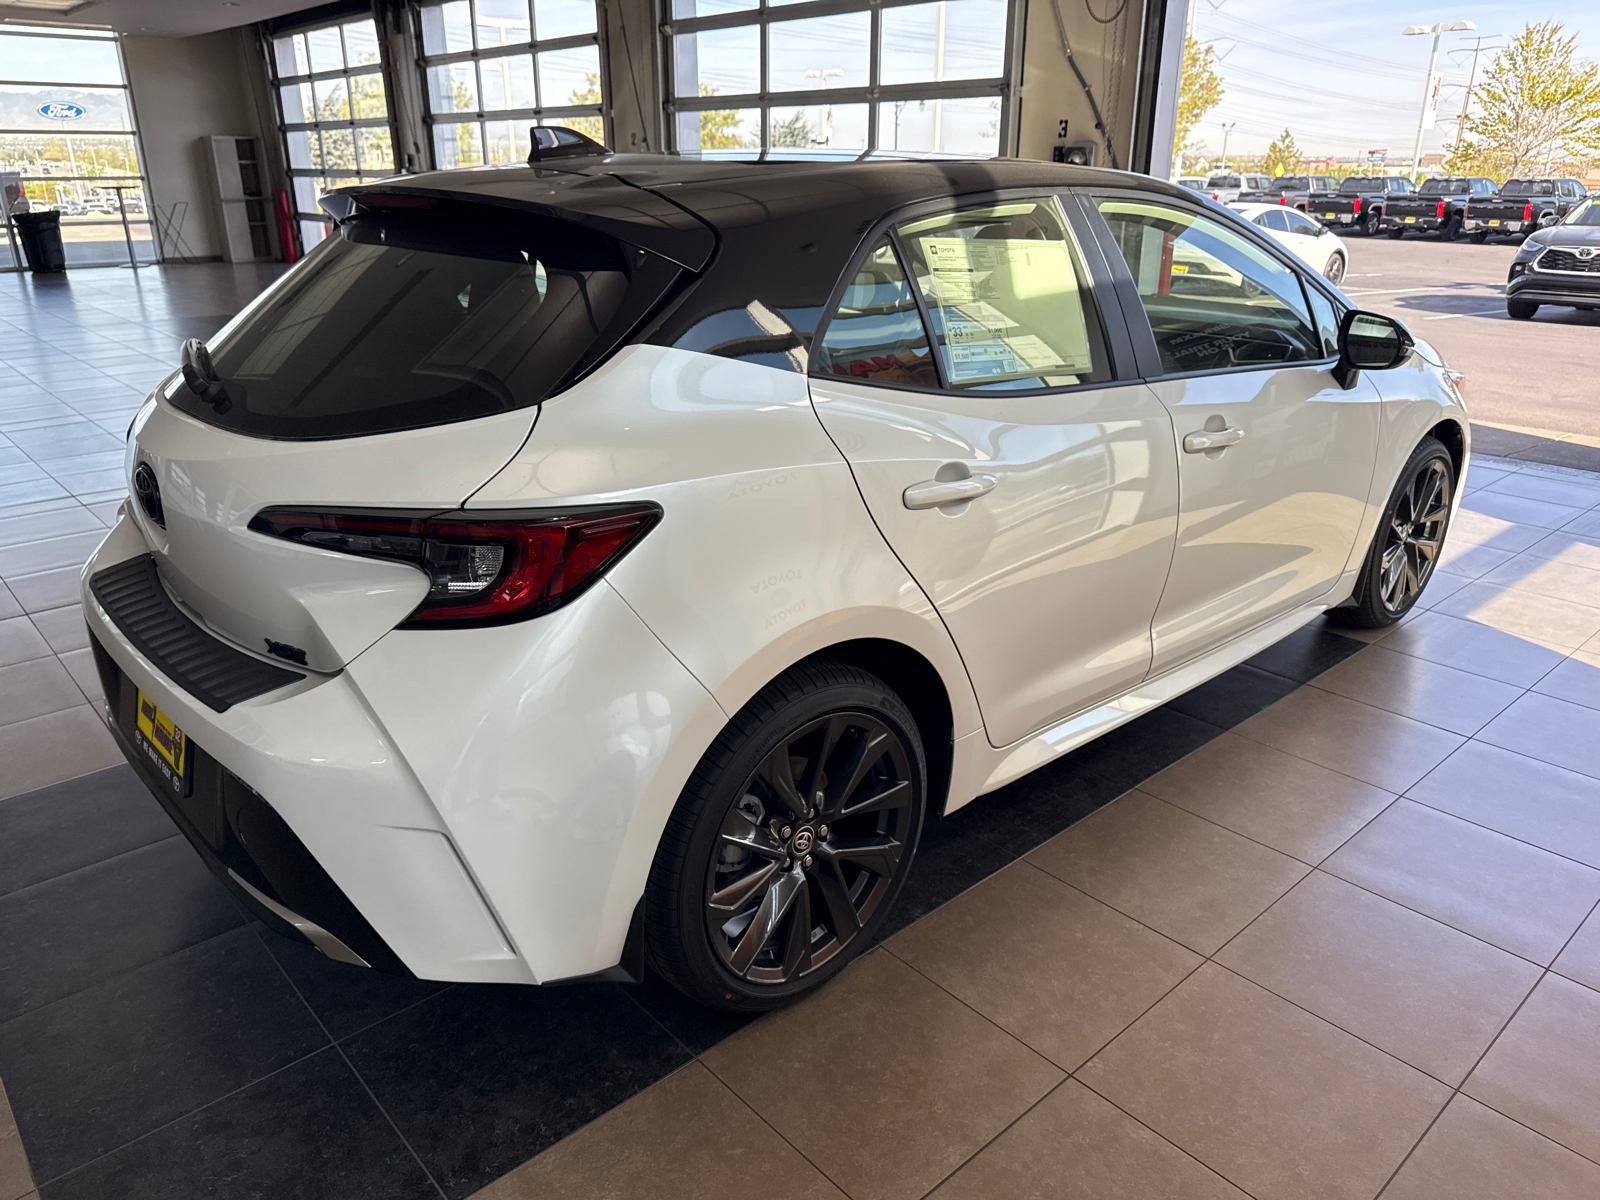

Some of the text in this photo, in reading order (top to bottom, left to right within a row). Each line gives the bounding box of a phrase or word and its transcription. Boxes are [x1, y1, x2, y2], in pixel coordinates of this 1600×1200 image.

[47, 104, 77, 117] Ford
[1058, 119, 1069, 139] 3
[630, 132, 637, 147] 2
[951, 326, 963, 337] 33
